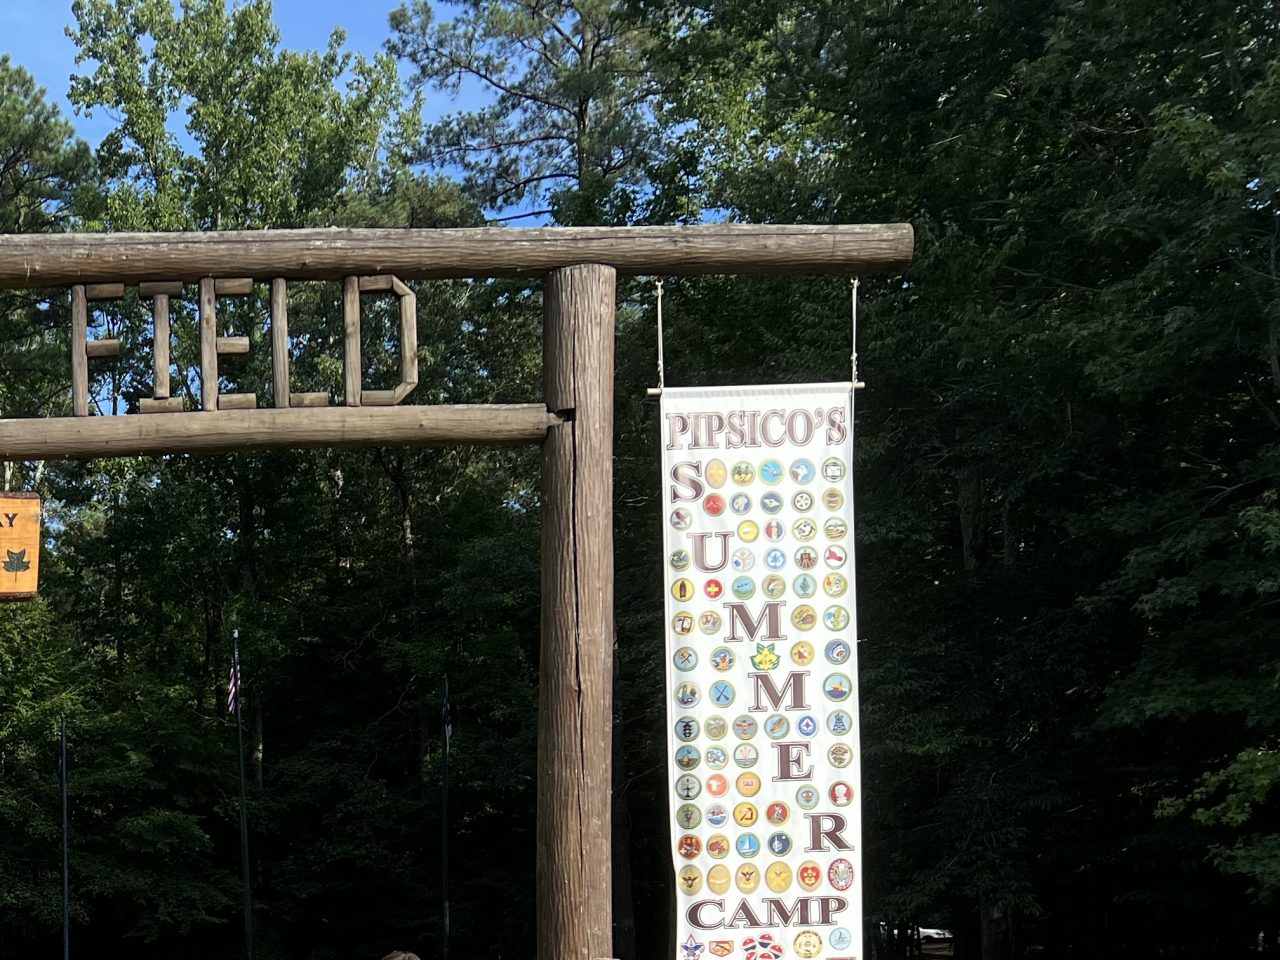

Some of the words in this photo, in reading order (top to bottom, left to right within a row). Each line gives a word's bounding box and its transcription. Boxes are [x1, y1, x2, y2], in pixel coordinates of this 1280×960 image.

[71, 274, 419, 417] FIELD
[665, 406, 848, 450] PIPSICO'S
[685, 895, 849, 930] CAMP
